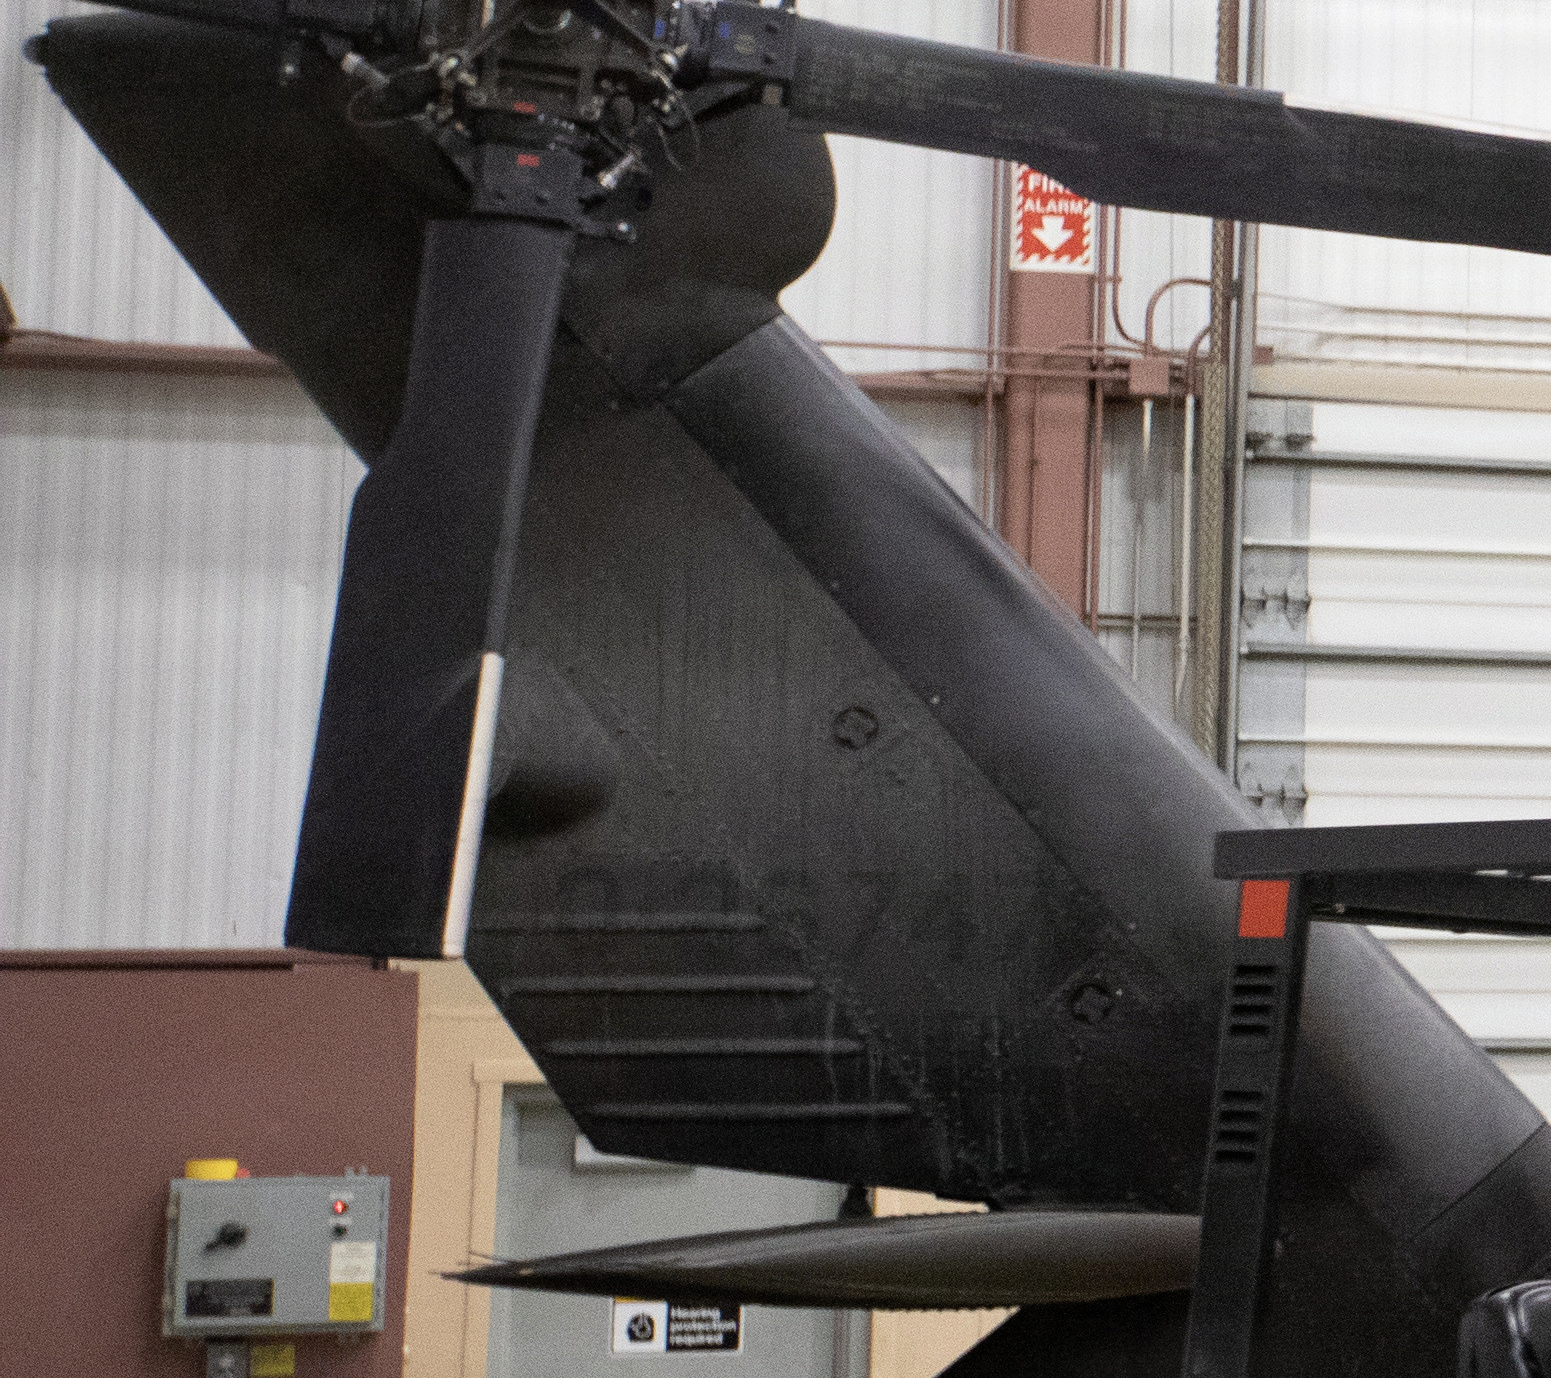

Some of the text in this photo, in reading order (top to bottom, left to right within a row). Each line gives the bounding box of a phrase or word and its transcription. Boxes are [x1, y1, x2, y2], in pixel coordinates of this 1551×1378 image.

[1028, 173, 1071, 195] FIR
[1024, 197, 1084, 215] ALARM
[670, 1321, 738, 1333] protection
[670, 1334, 724, 1346] required
